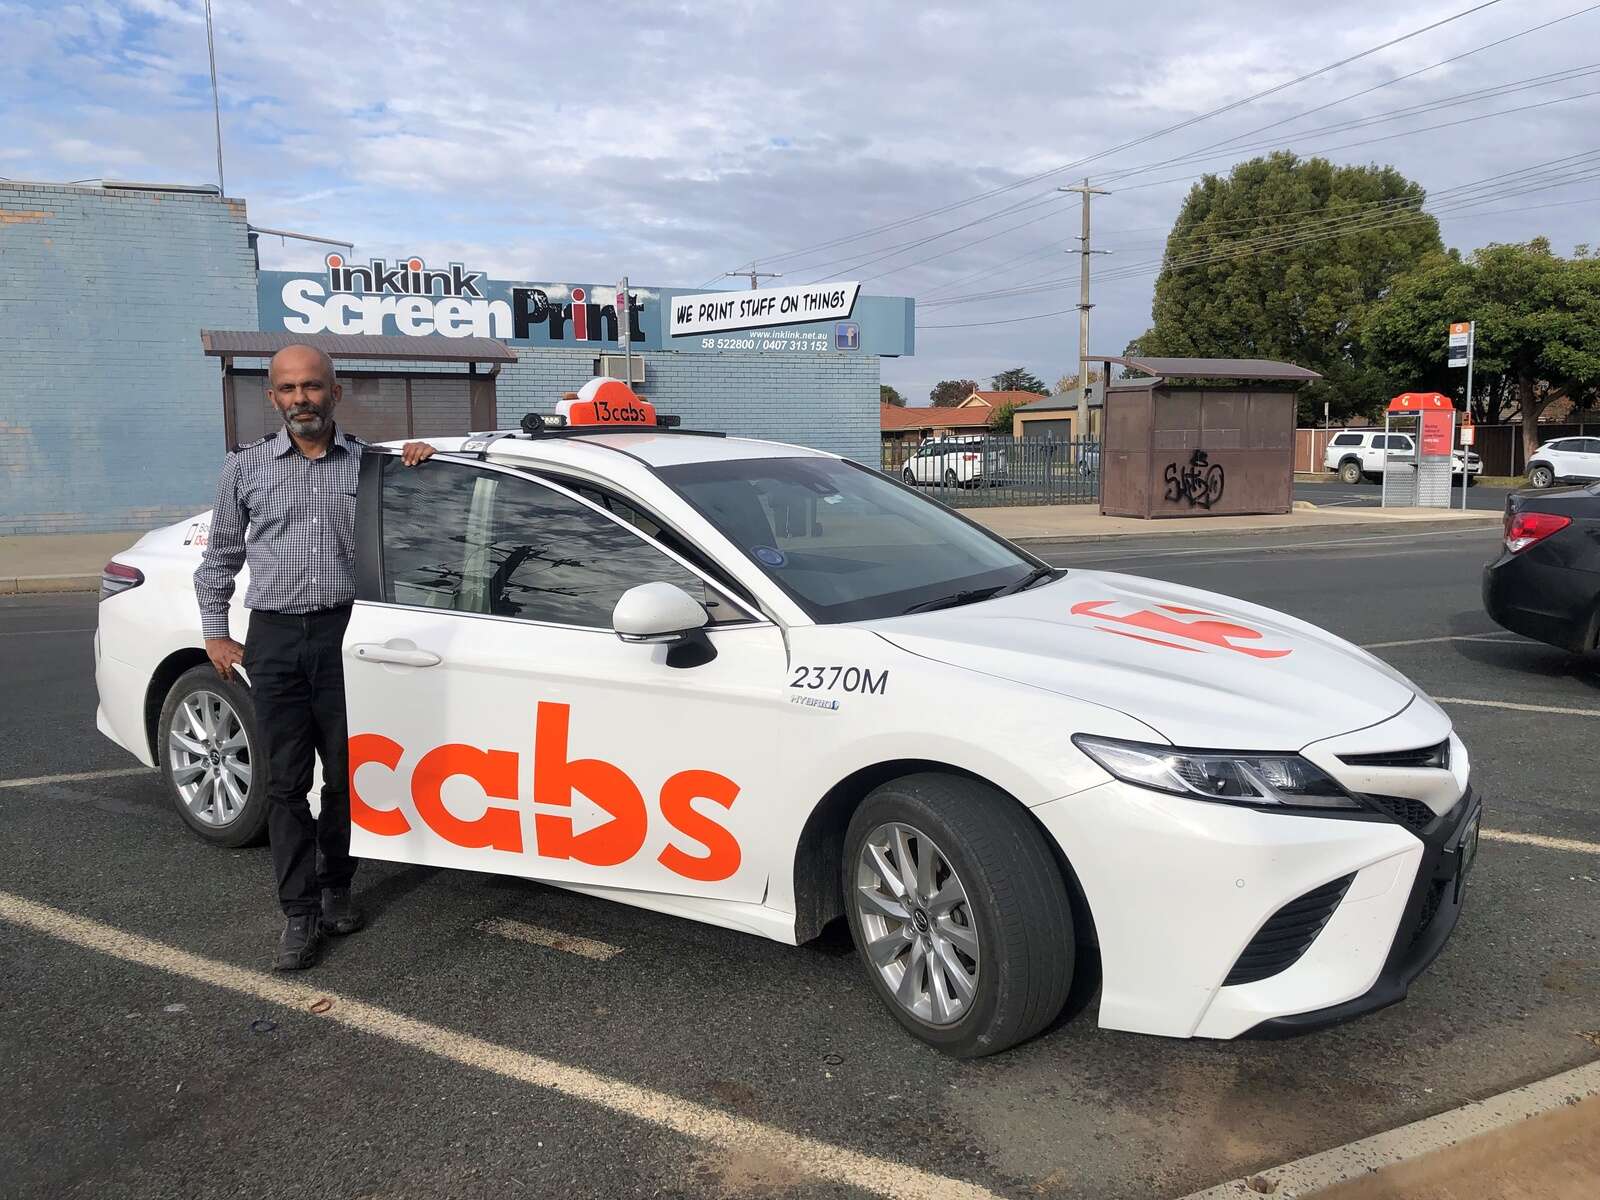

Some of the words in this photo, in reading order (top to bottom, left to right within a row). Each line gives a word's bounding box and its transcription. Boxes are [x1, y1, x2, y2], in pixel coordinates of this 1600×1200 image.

[327, 254, 483, 298] inklink
[676, 305, 693, 325] WE
[698, 300, 735, 323] PRINT
[739, 296, 776, 318] STUFF
[780, 294, 799, 314] ON
[803, 290, 846, 310] THINGS
[701, 338, 715, 350] 58
[716, 339, 755, 350] 522800
[762, 340, 787, 351] 0407
[789, 341, 808, 351] 313
[810, 341, 828, 352] 152
[749, 330, 828, 341] www.inklink.net.au
[593, 401, 646, 422] 13cabs
[789, 665, 889, 695] 2370M
[348, 701, 742, 882] cabs
